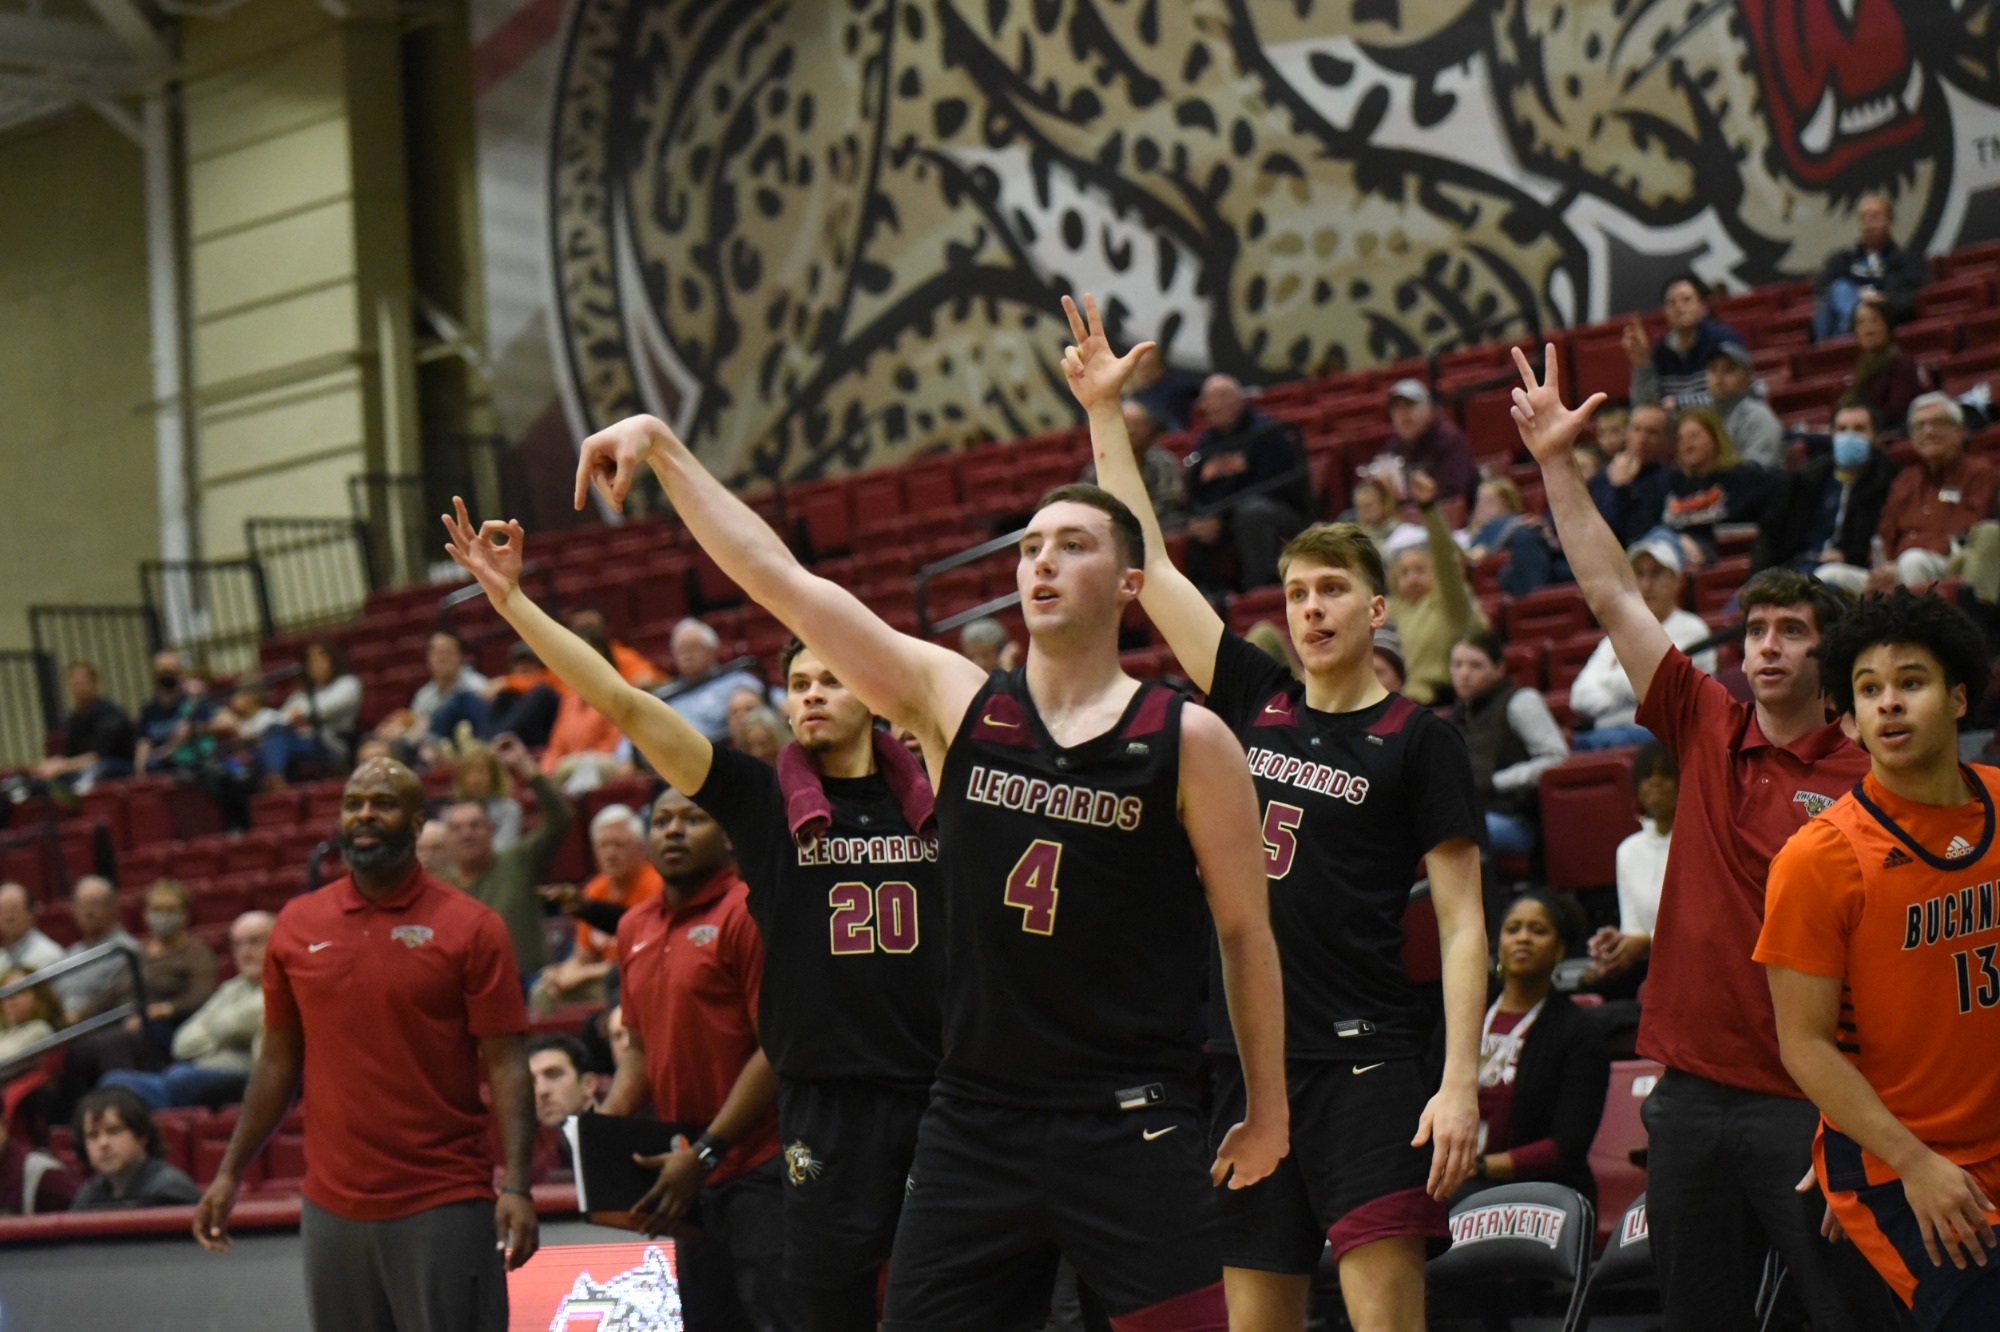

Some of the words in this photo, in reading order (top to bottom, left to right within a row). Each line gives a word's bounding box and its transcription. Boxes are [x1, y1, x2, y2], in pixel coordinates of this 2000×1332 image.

[966, 766, 1143, 831] LEOPARDS
[1247, 747, 1370, 805] LEOPARDS
[1262, 800, 1304, 880] 5
[829, 881, 919, 955] 20
[1004, 838, 1062, 936] 4
[1901, 879, 2000, 950] BUCKN
[1950, 943, 2000, 1014] 13
